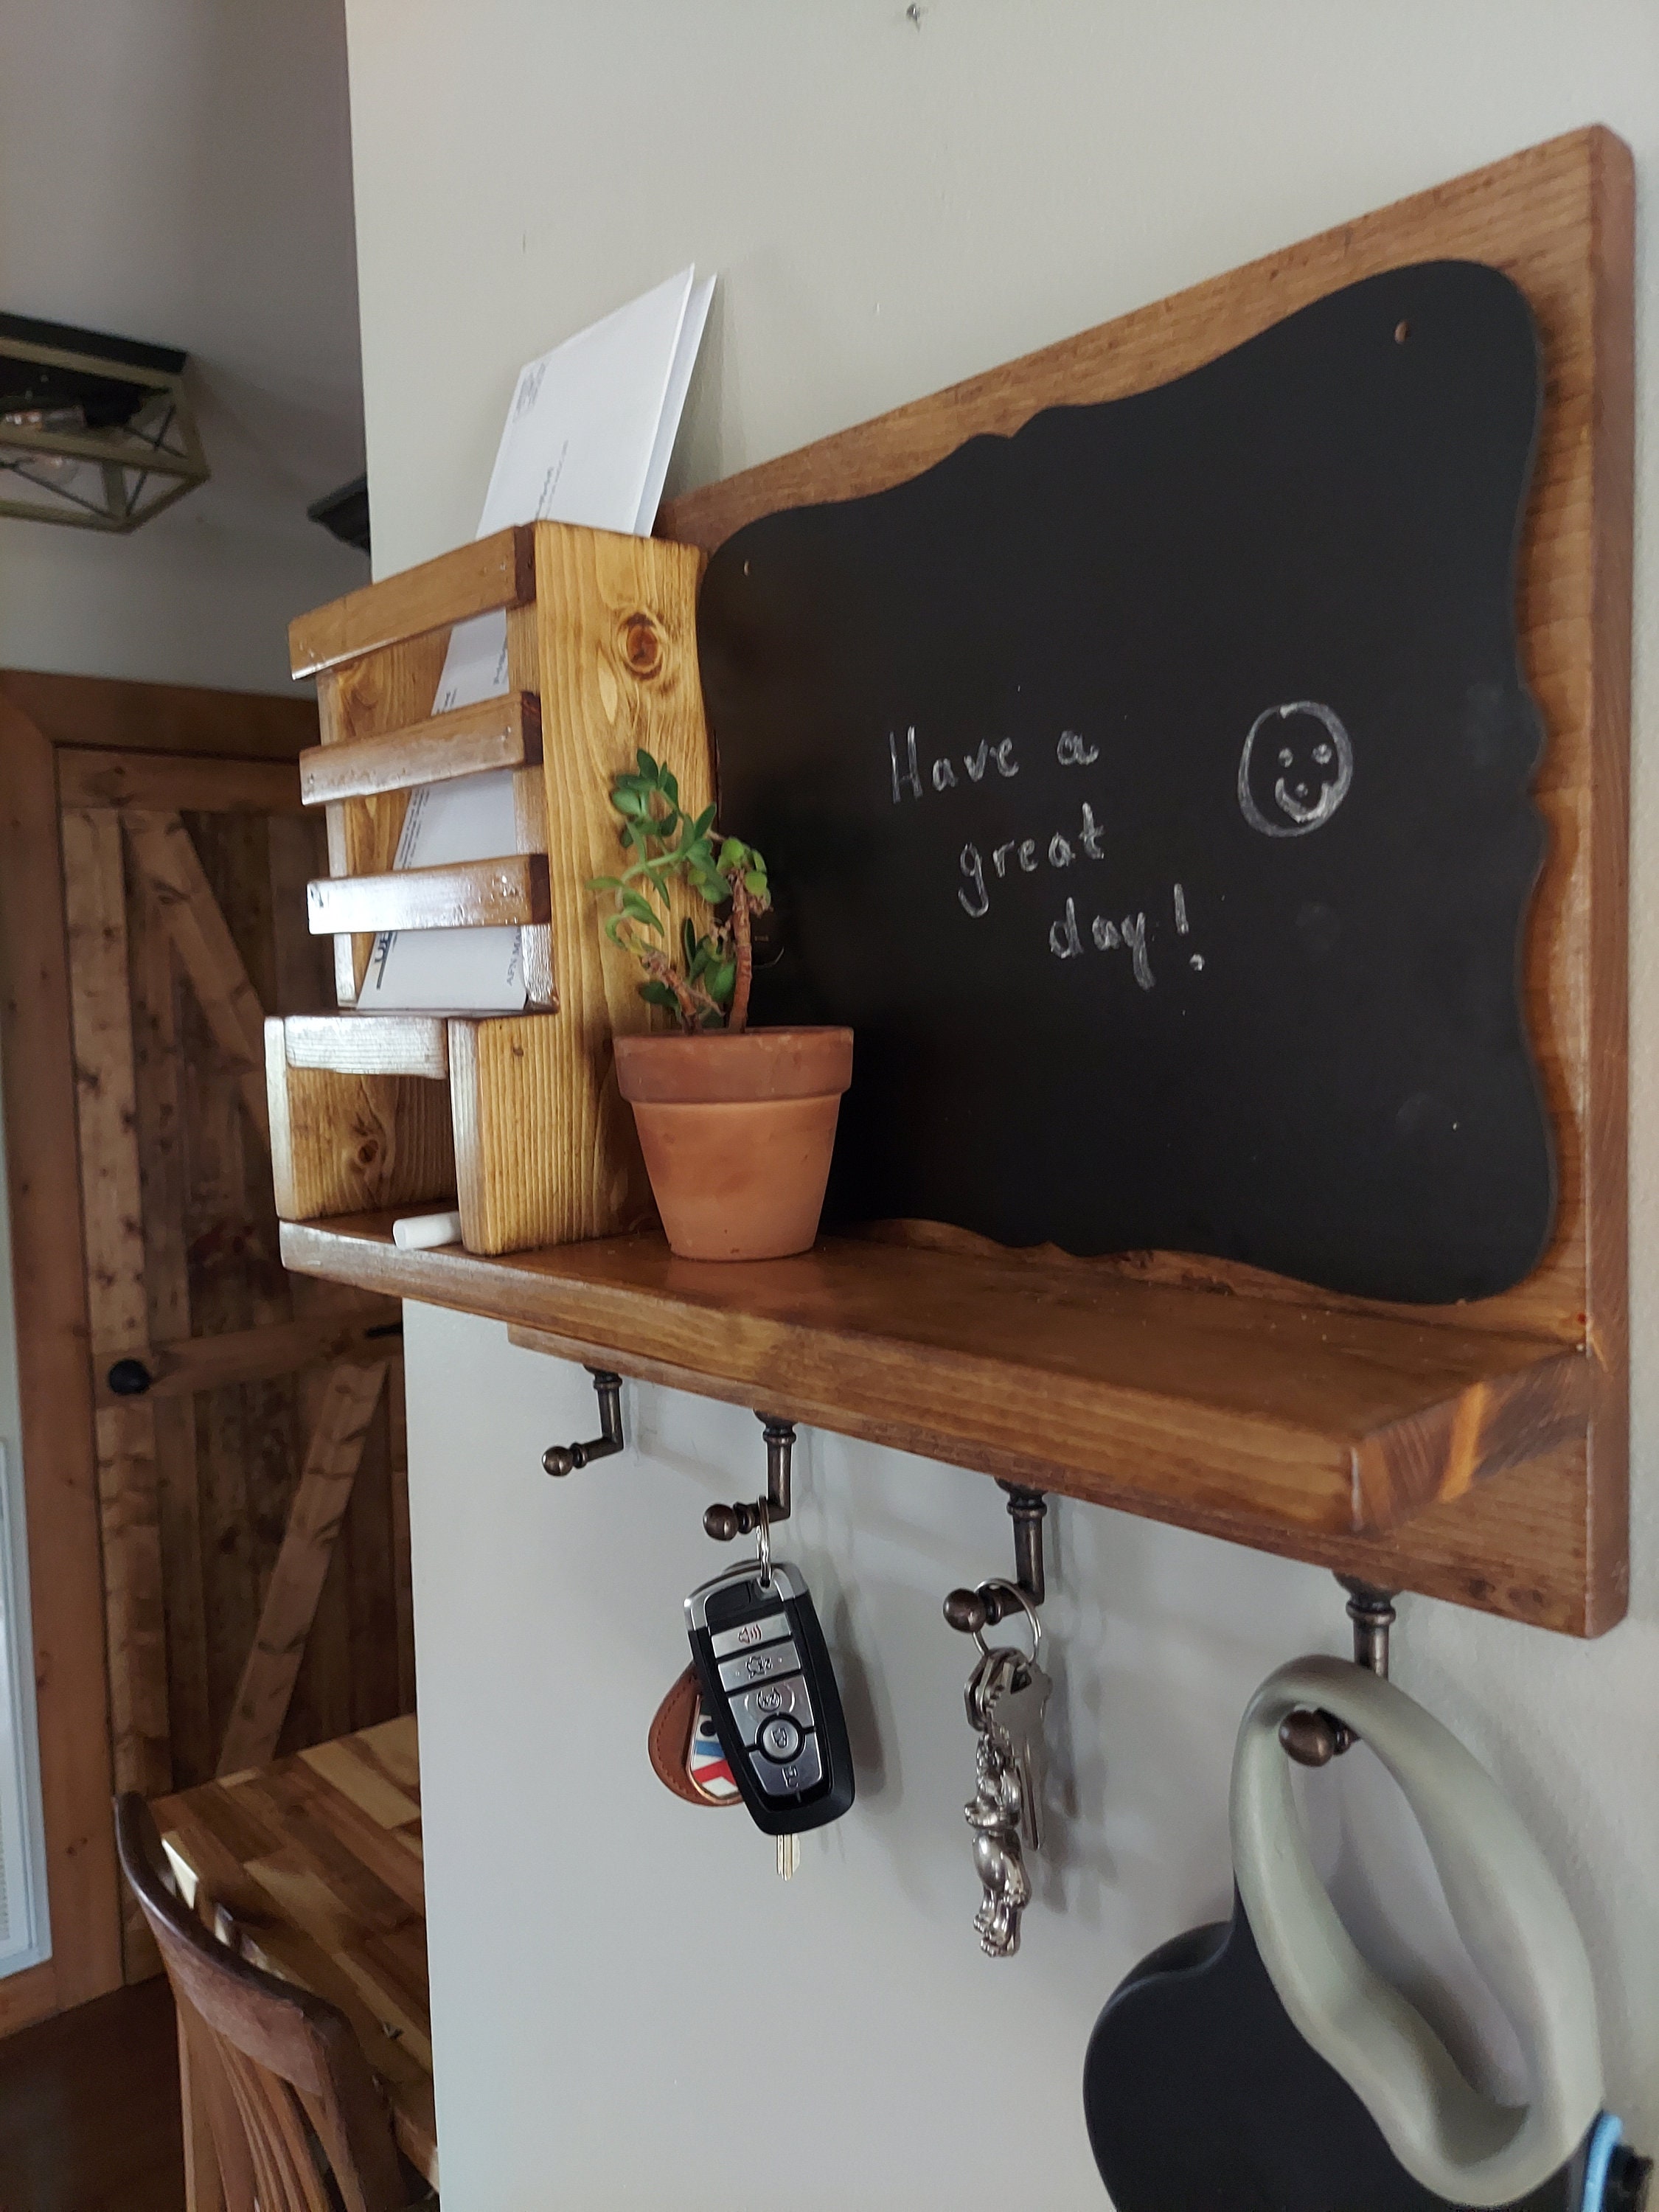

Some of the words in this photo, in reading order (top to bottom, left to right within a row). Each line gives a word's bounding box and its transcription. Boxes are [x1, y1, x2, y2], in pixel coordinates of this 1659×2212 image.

[890, 726, 1018, 803] Have
[1057, 729, 1099, 766] a
[959, 801, 1105, 917] great
[1049, 883, 1205, 990] day!
